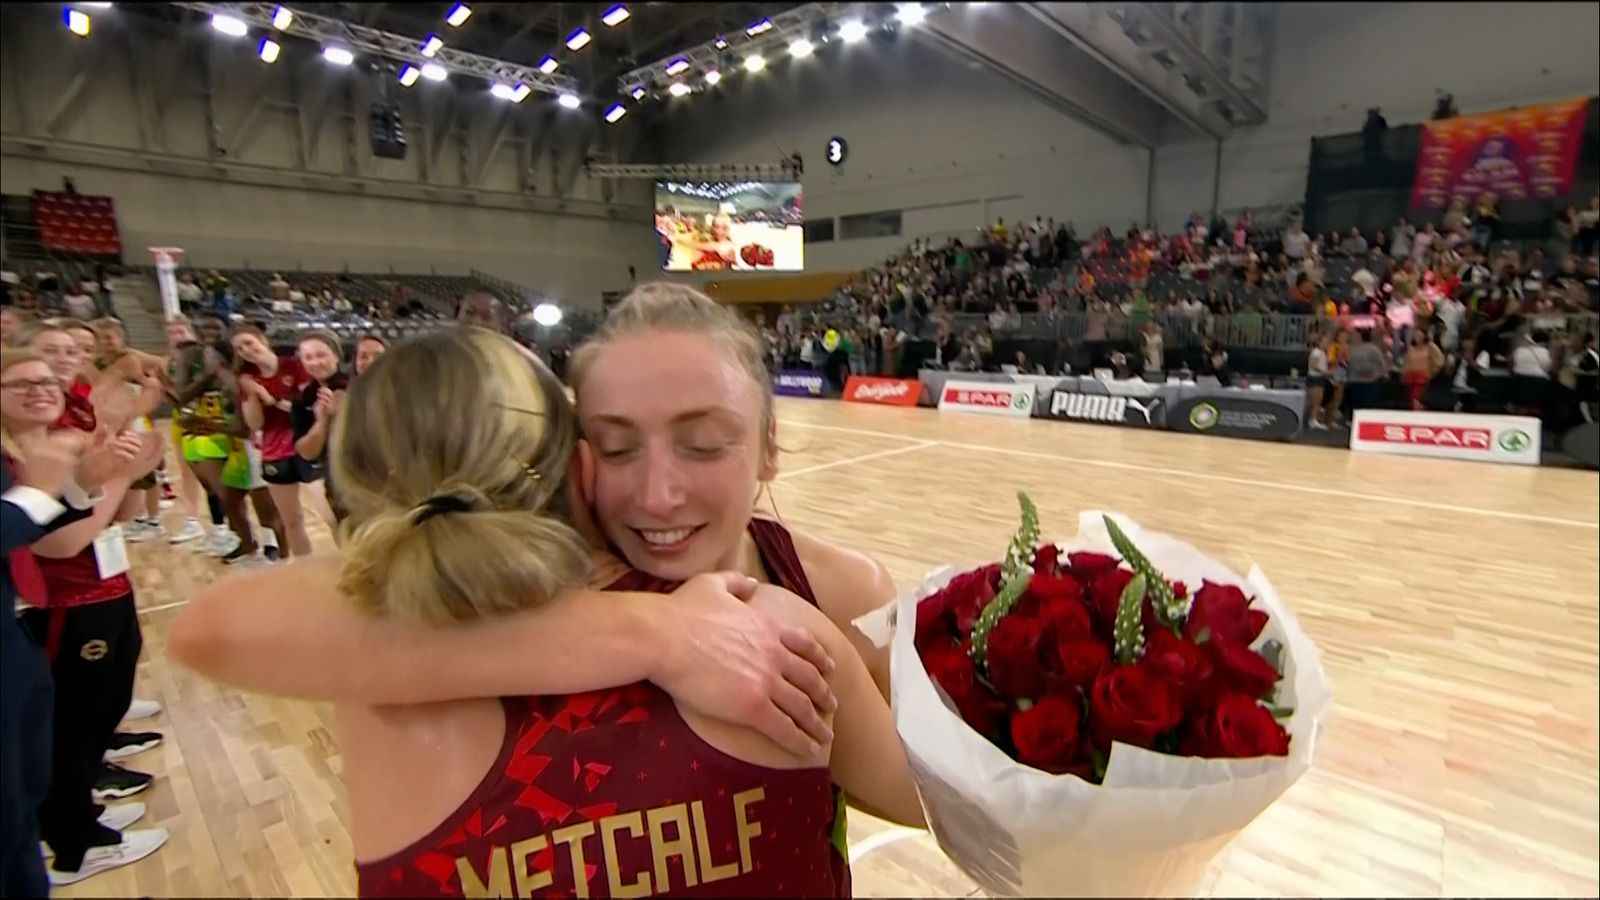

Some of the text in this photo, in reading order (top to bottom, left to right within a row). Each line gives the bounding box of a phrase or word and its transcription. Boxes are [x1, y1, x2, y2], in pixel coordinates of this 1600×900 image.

[829, 140, 842, 163] 3
[956, 390, 1013, 408] SPAR
[1051, 390, 1127, 422] PUMA
[1382, 425, 1490, 448] SPAR
[455, 787, 766, 898] METCALF
